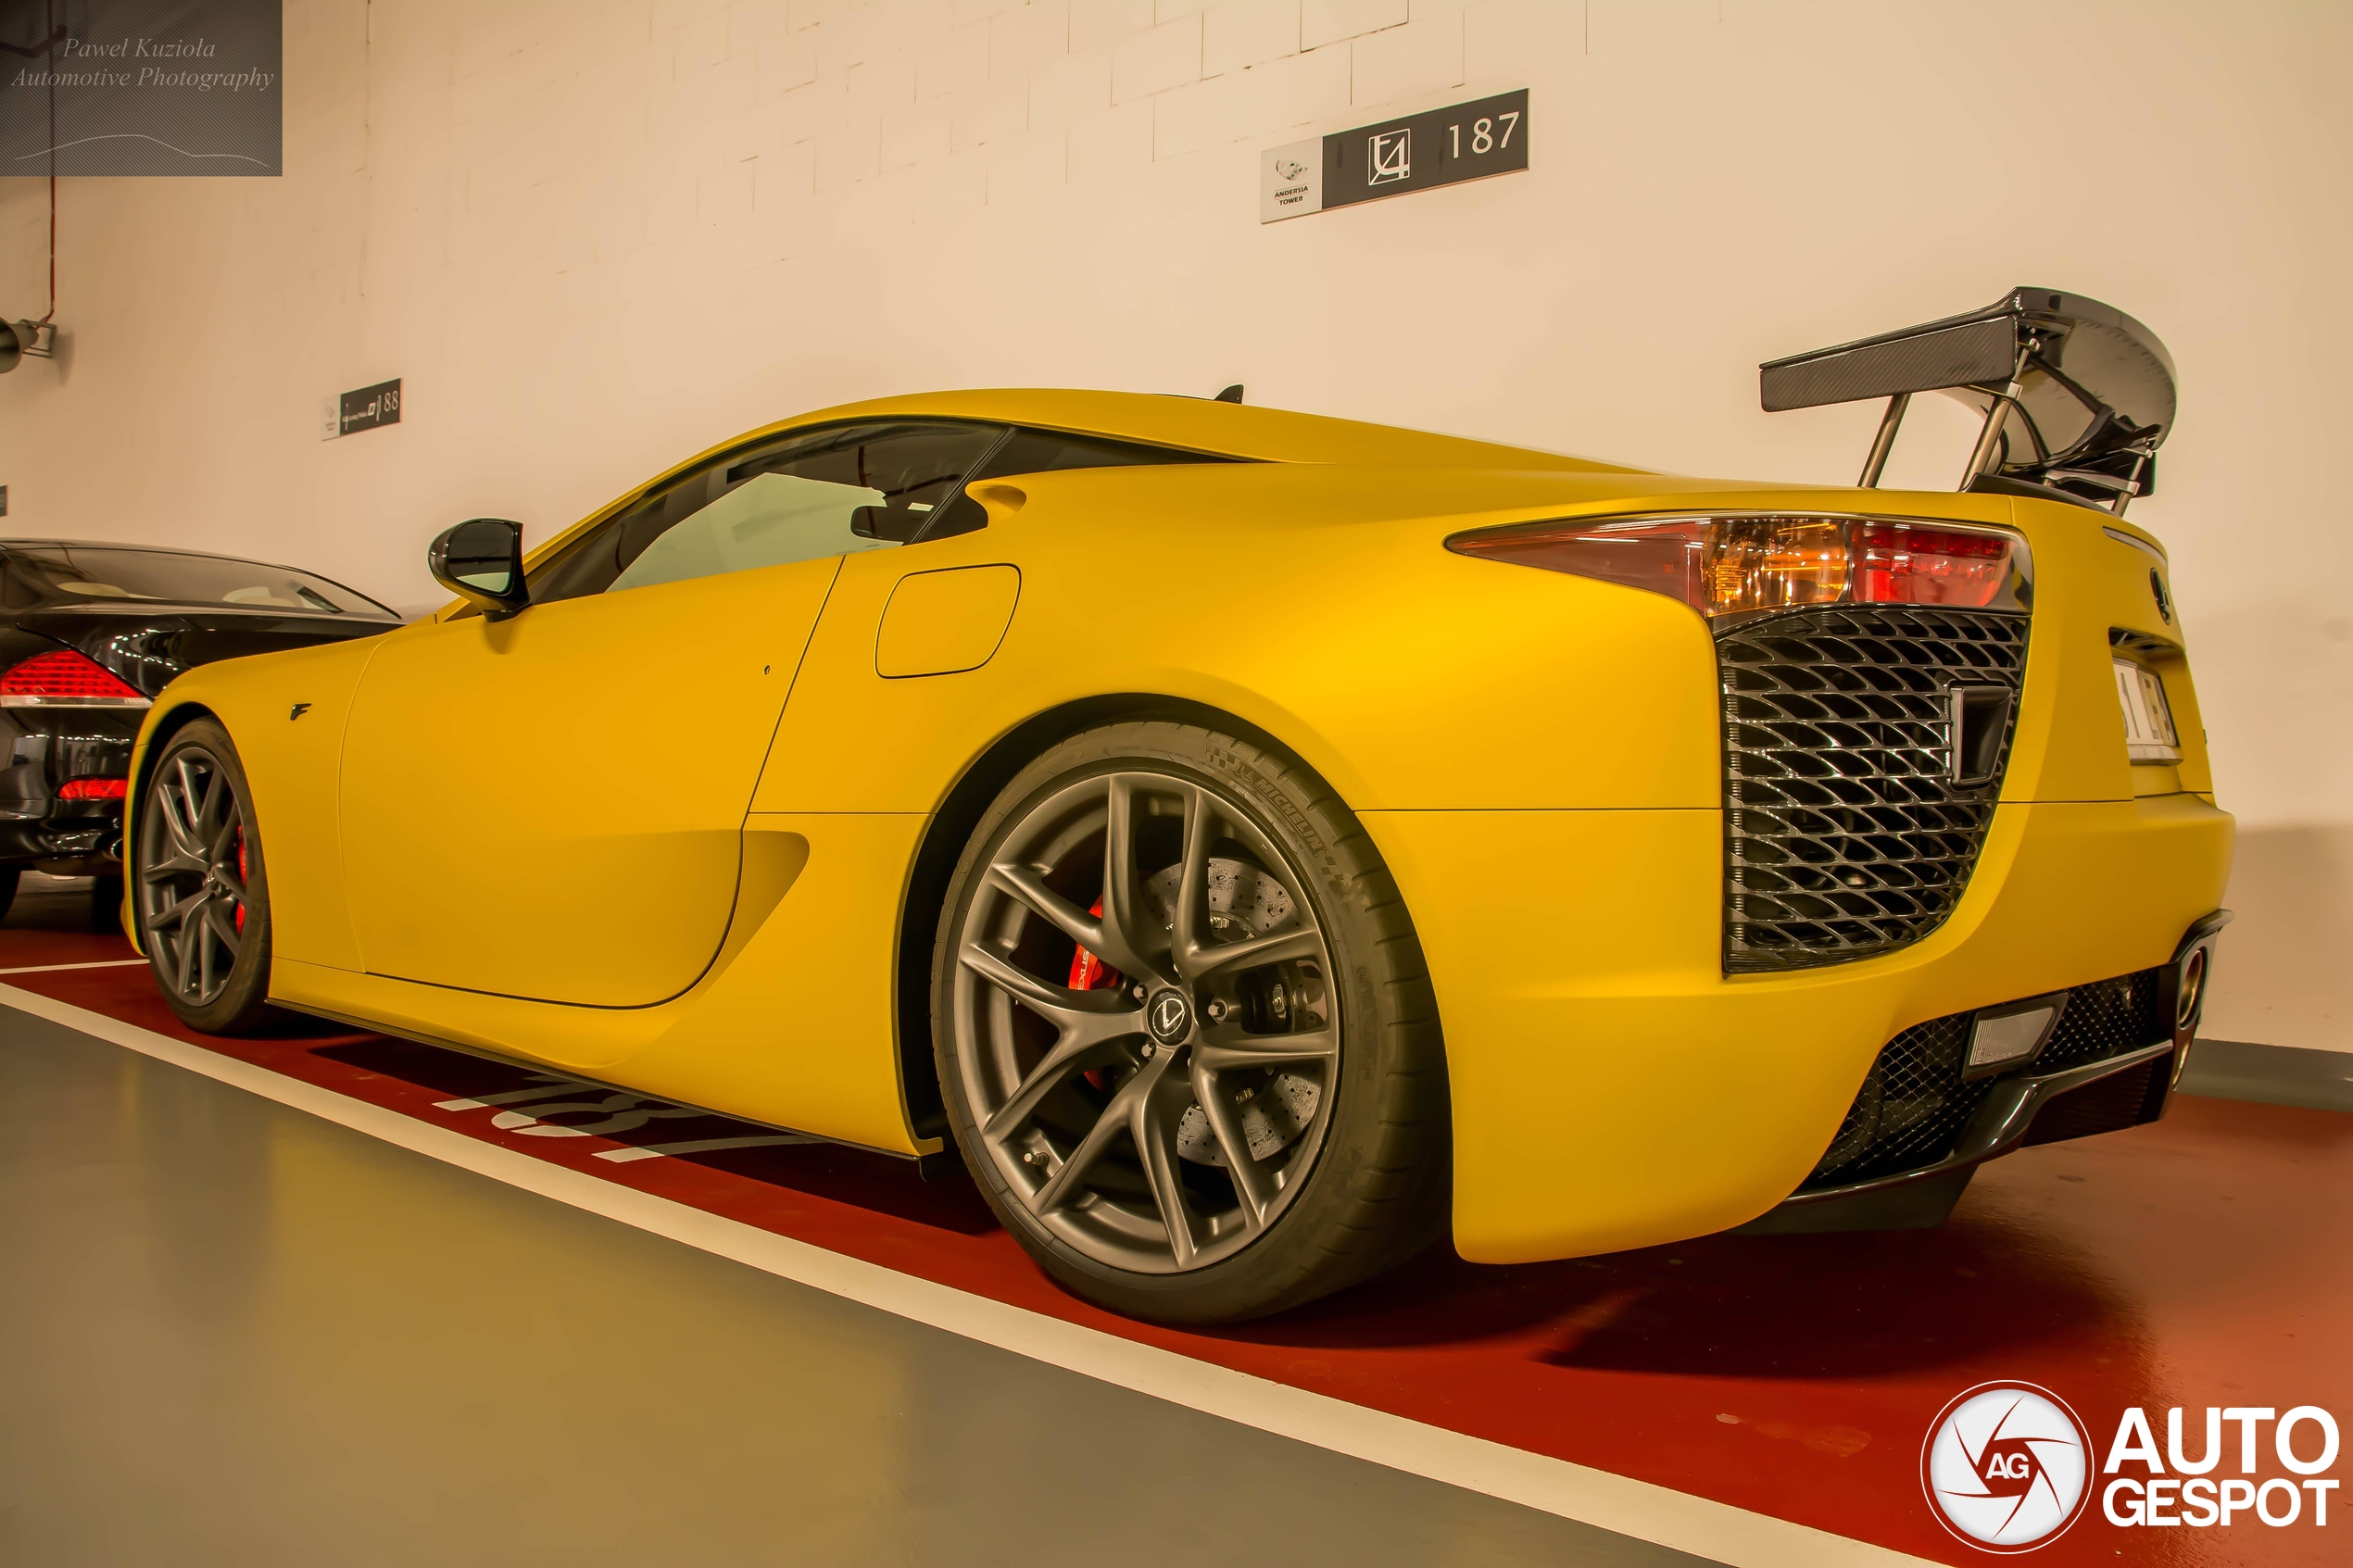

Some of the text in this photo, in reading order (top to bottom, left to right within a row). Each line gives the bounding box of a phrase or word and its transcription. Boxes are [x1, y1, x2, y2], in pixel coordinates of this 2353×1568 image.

[1448, 110, 1520, 159] 187
[1274, 185, 1309, 198] ANDERSIA
[1279, 195, 1303, 206] TOWER
[1254, 778, 1326, 850] MICHELIN
[1077, 949, 1089, 990] EXUS
